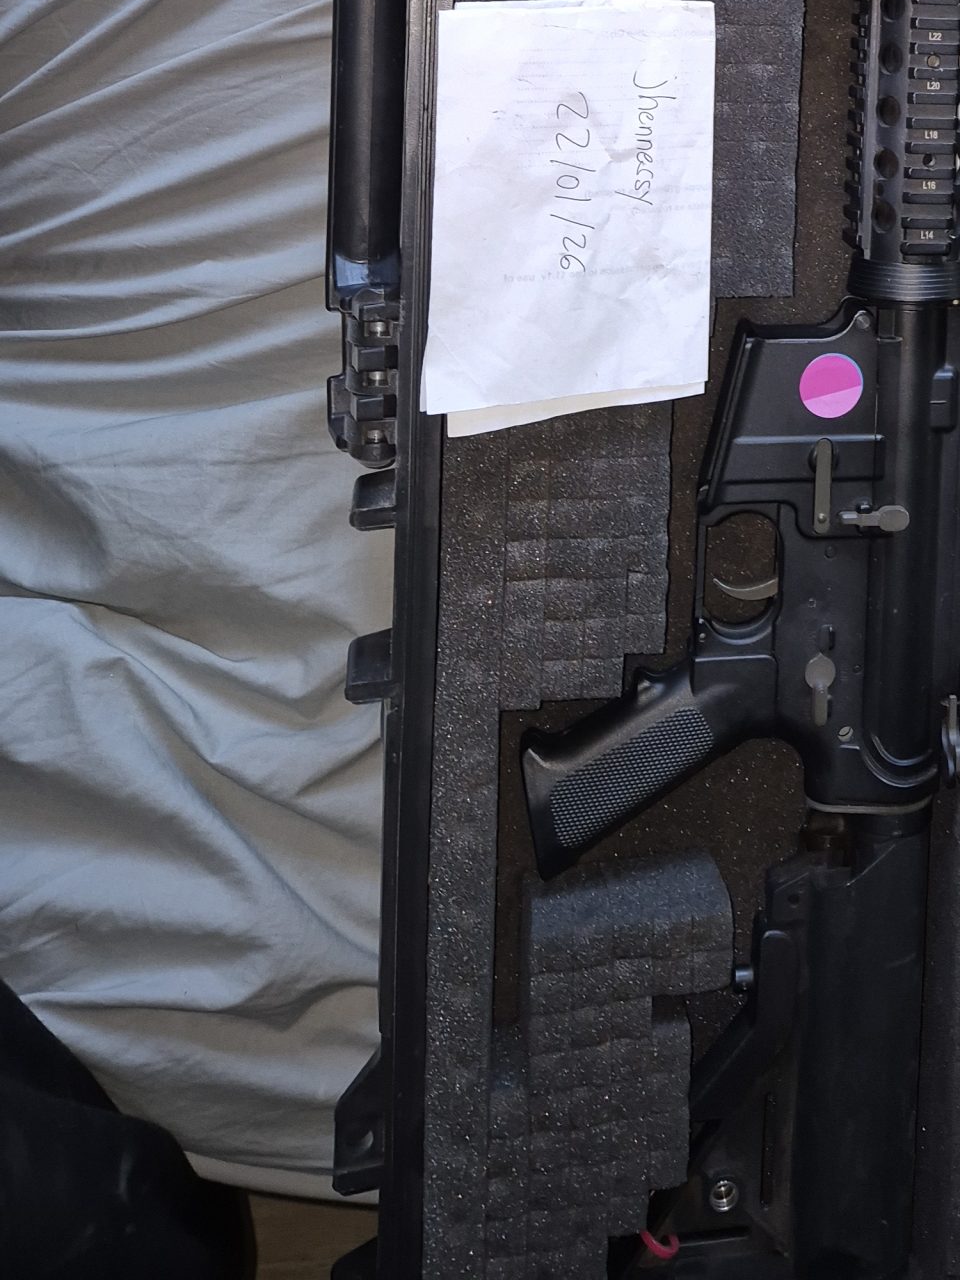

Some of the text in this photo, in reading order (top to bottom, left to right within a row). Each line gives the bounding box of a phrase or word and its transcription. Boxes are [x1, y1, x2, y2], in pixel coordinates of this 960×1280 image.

[928, 32, 942, 41] L22
[927, 81, 940, 90] L20
[924, 130, 938, 139] L18
[549, 91, 597, 272] 22/01/26
[922, 181, 936, 190] L16
[920, 230, 934, 239] L14
